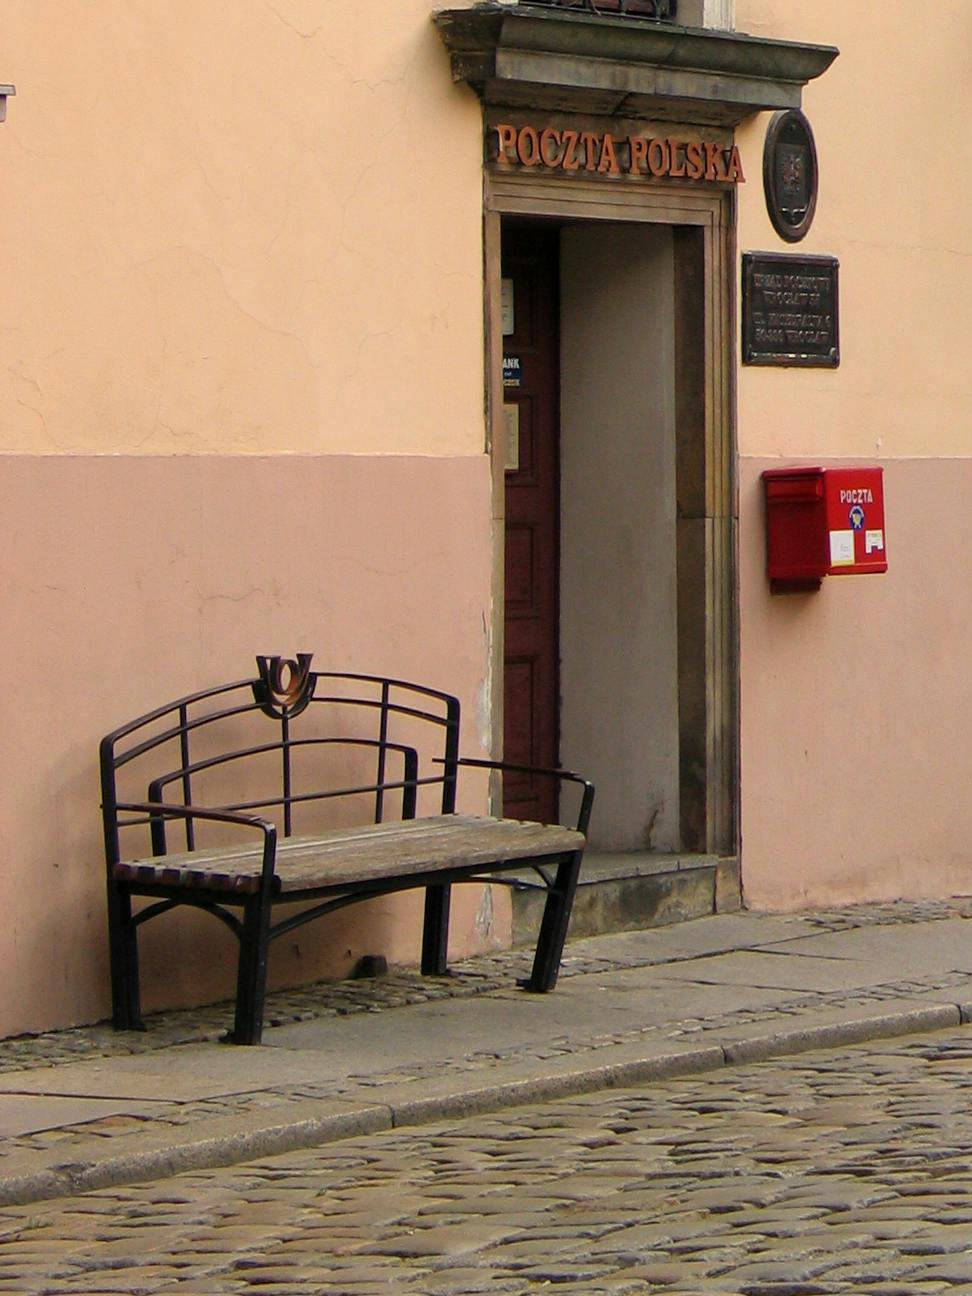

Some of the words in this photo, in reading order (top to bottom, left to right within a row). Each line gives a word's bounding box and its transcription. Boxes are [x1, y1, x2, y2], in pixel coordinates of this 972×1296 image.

[496, 124, 620, 174] POCZTA
[629, 135, 746, 183] POLSKA
[503, 358, 520, 369] ANK
[840, 489, 873, 504] POCZTA
